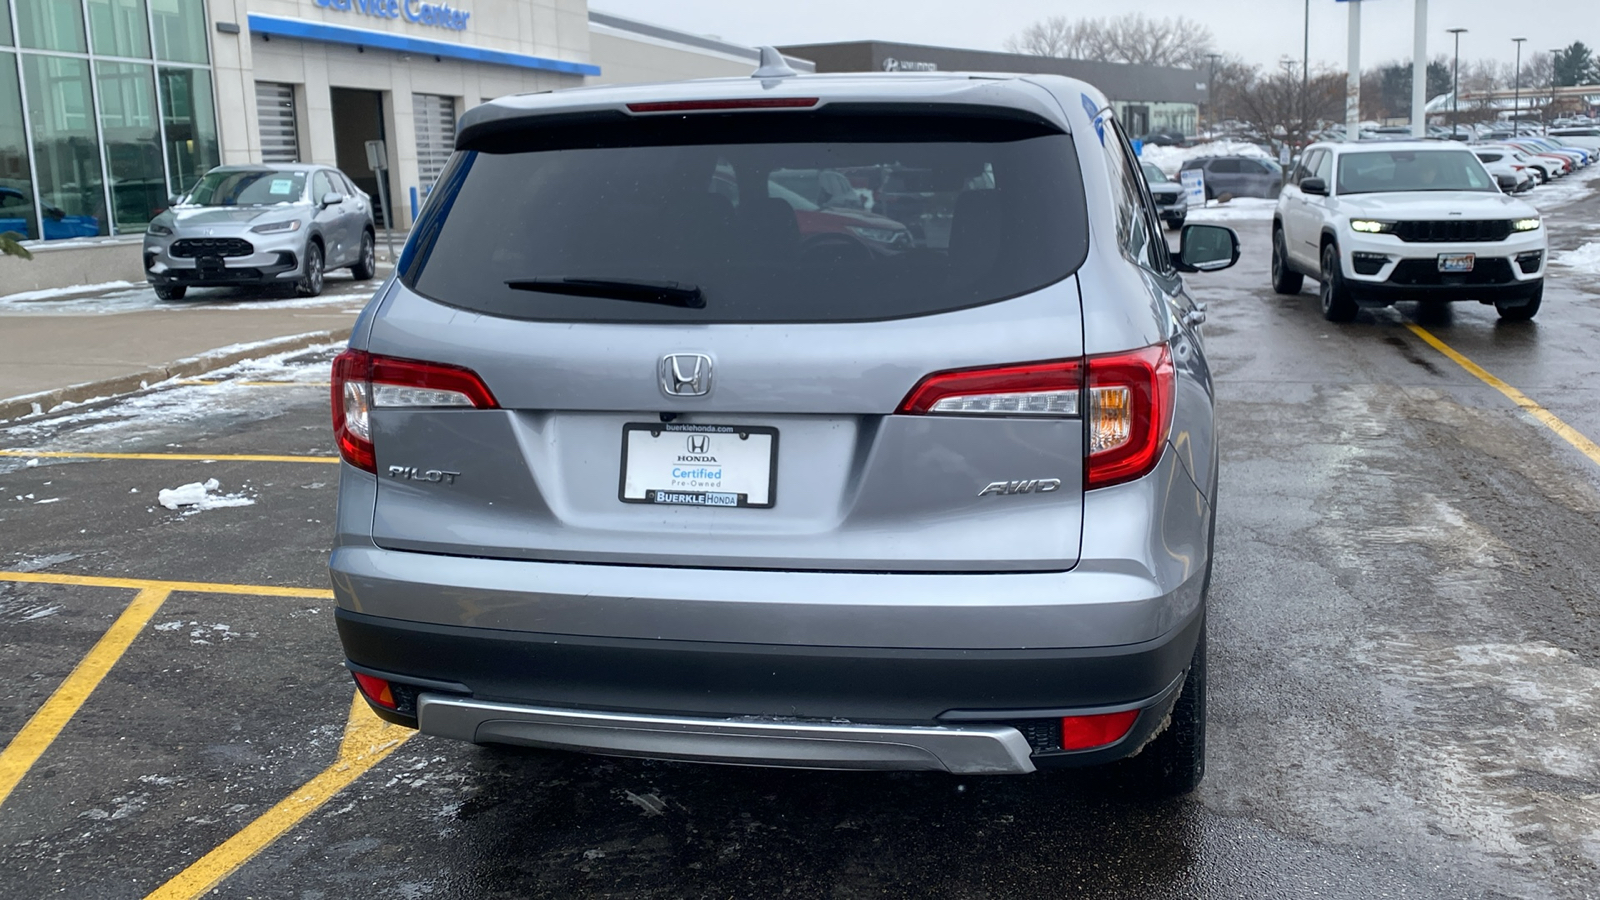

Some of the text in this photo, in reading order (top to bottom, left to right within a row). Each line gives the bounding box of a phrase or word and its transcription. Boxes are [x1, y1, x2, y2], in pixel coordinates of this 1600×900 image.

[312, 0, 470, 31] ervice Center
[665, 423, 734, 434] buerklehonda.com
[677, 455, 717, 463] HONDA
[388, 464, 461, 486] PILOT
[672, 467, 722, 479] Certified
[671, 479, 721, 488] Pre-Owned
[977, 477, 1061, 497] AWD
